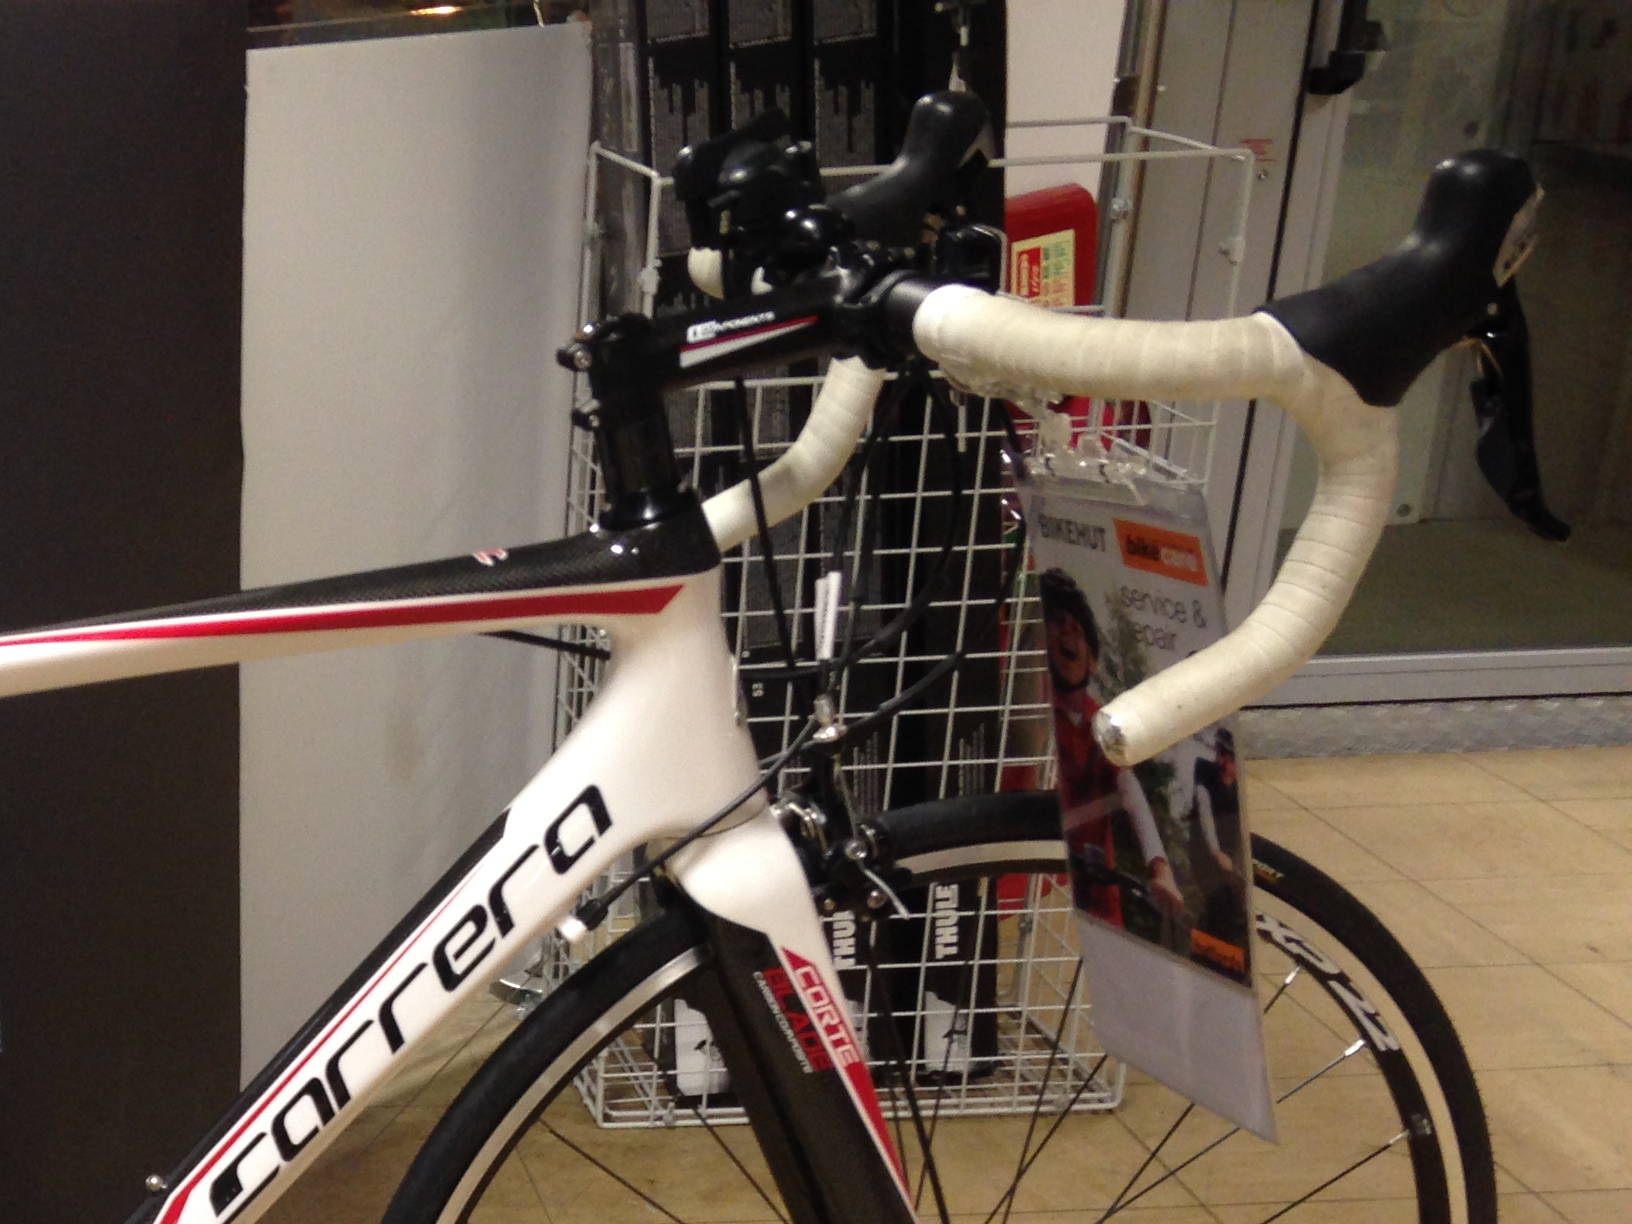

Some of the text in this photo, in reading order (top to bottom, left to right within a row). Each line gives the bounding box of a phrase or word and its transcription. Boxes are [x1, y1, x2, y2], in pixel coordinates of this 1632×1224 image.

[832, 910, 857, 968] THUL
[935, 884, 959, 959] THULE
[795, 964, 862, 1068] CORTE
